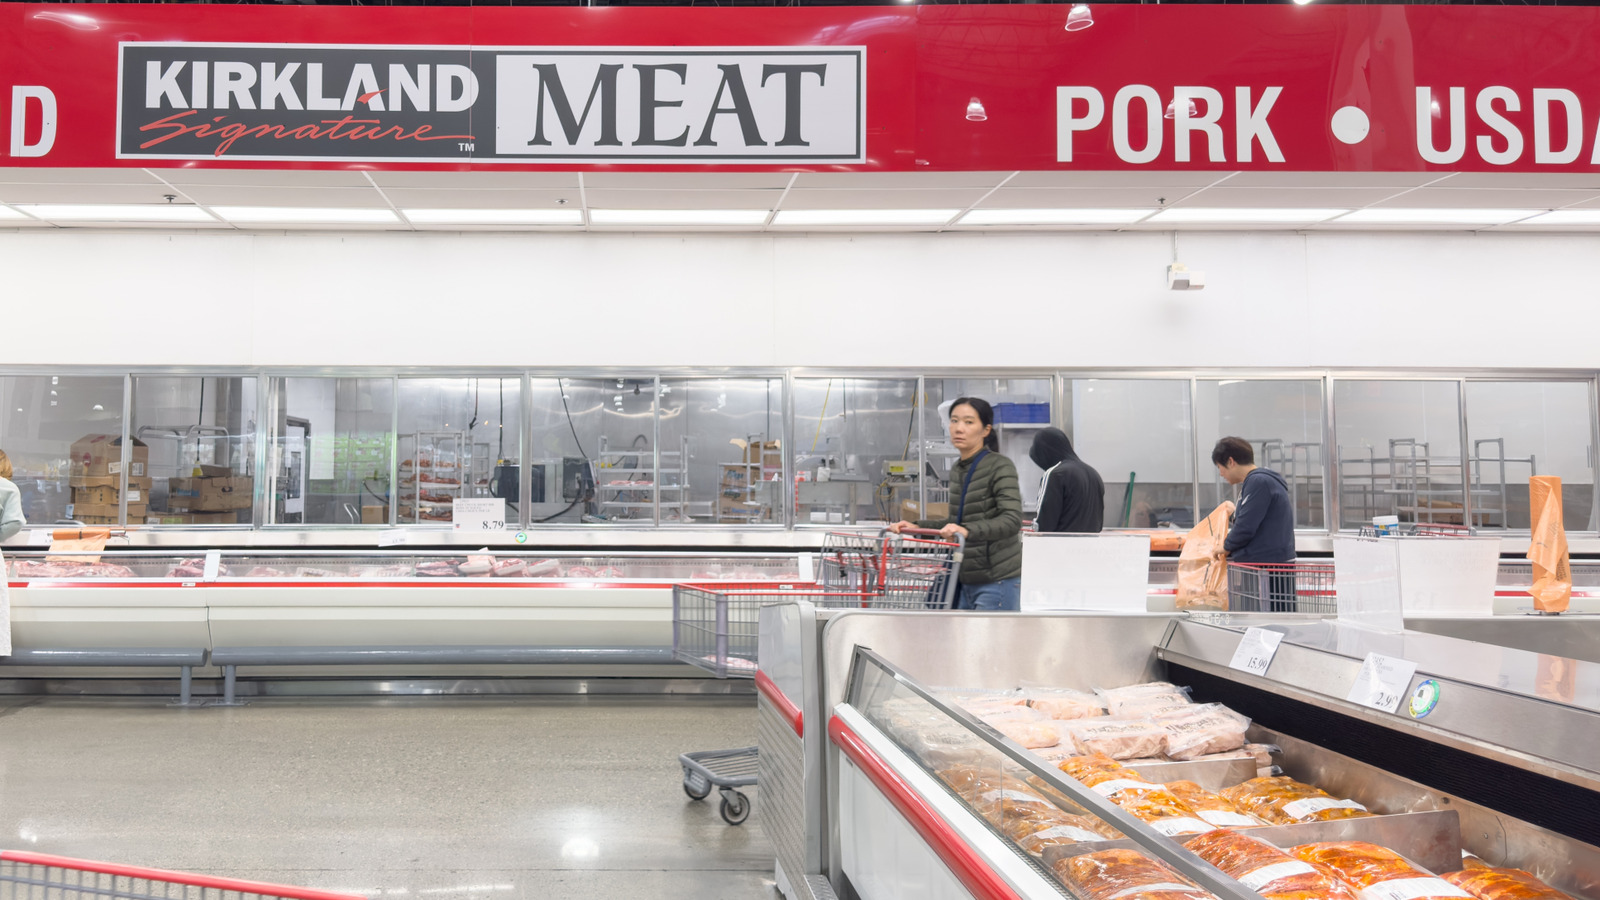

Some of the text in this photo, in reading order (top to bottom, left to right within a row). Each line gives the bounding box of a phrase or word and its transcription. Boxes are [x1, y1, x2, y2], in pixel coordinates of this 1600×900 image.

[145, 60, 480, 113] KIRKLAND
[527, 63, 828, 147] MEAT
[10, 85, 58, 157] D
[140, 109, 476, 157] Signature
[1056, 84, 1600, 166] PORK USD
[482, 521, 504, 529] 8.79
[1247, 657, 1268, 670] 15.99
